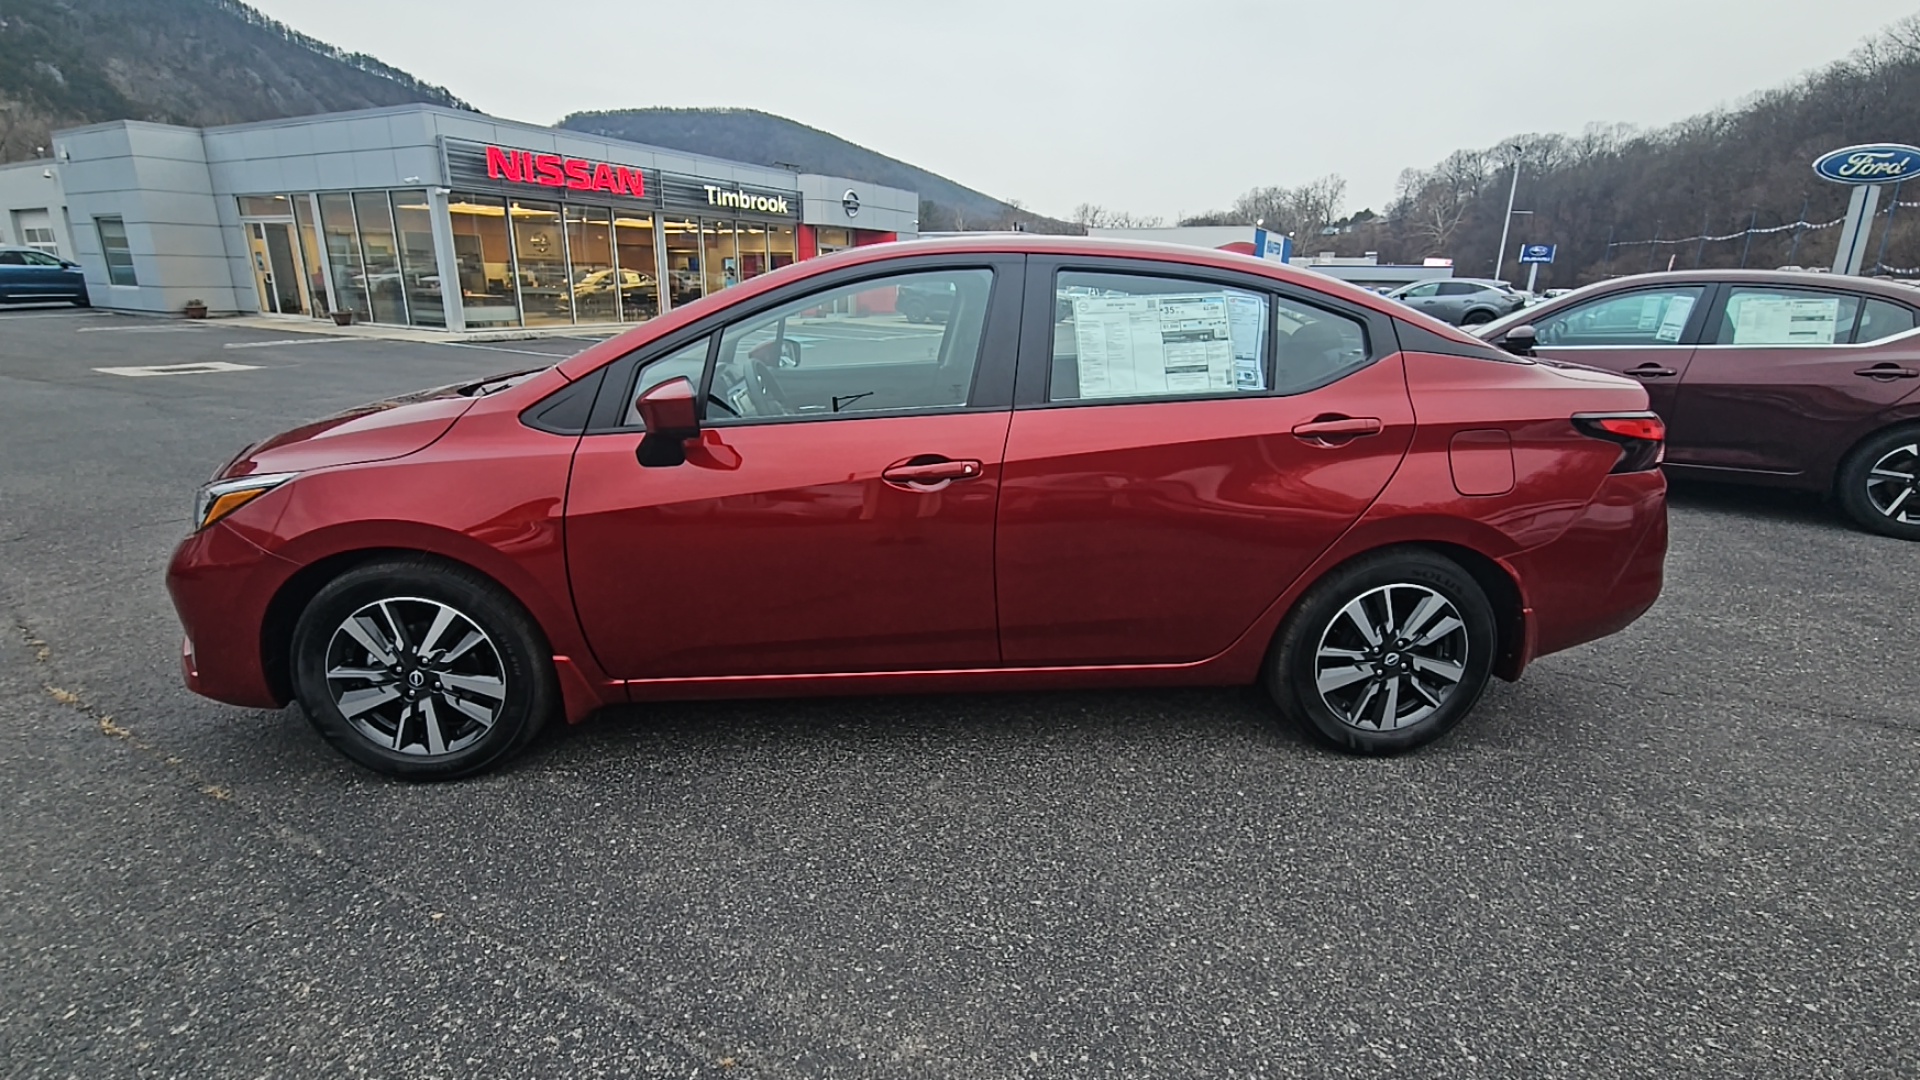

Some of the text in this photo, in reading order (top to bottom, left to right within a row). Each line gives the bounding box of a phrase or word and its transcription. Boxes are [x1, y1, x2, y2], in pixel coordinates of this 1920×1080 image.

[485, 145, 645, 197] NISSAN
[1839, 152, 1911, 176] Ford
[703, 184, 788, 214] Timbrook
[1164, 306, 1175, 315] 35
